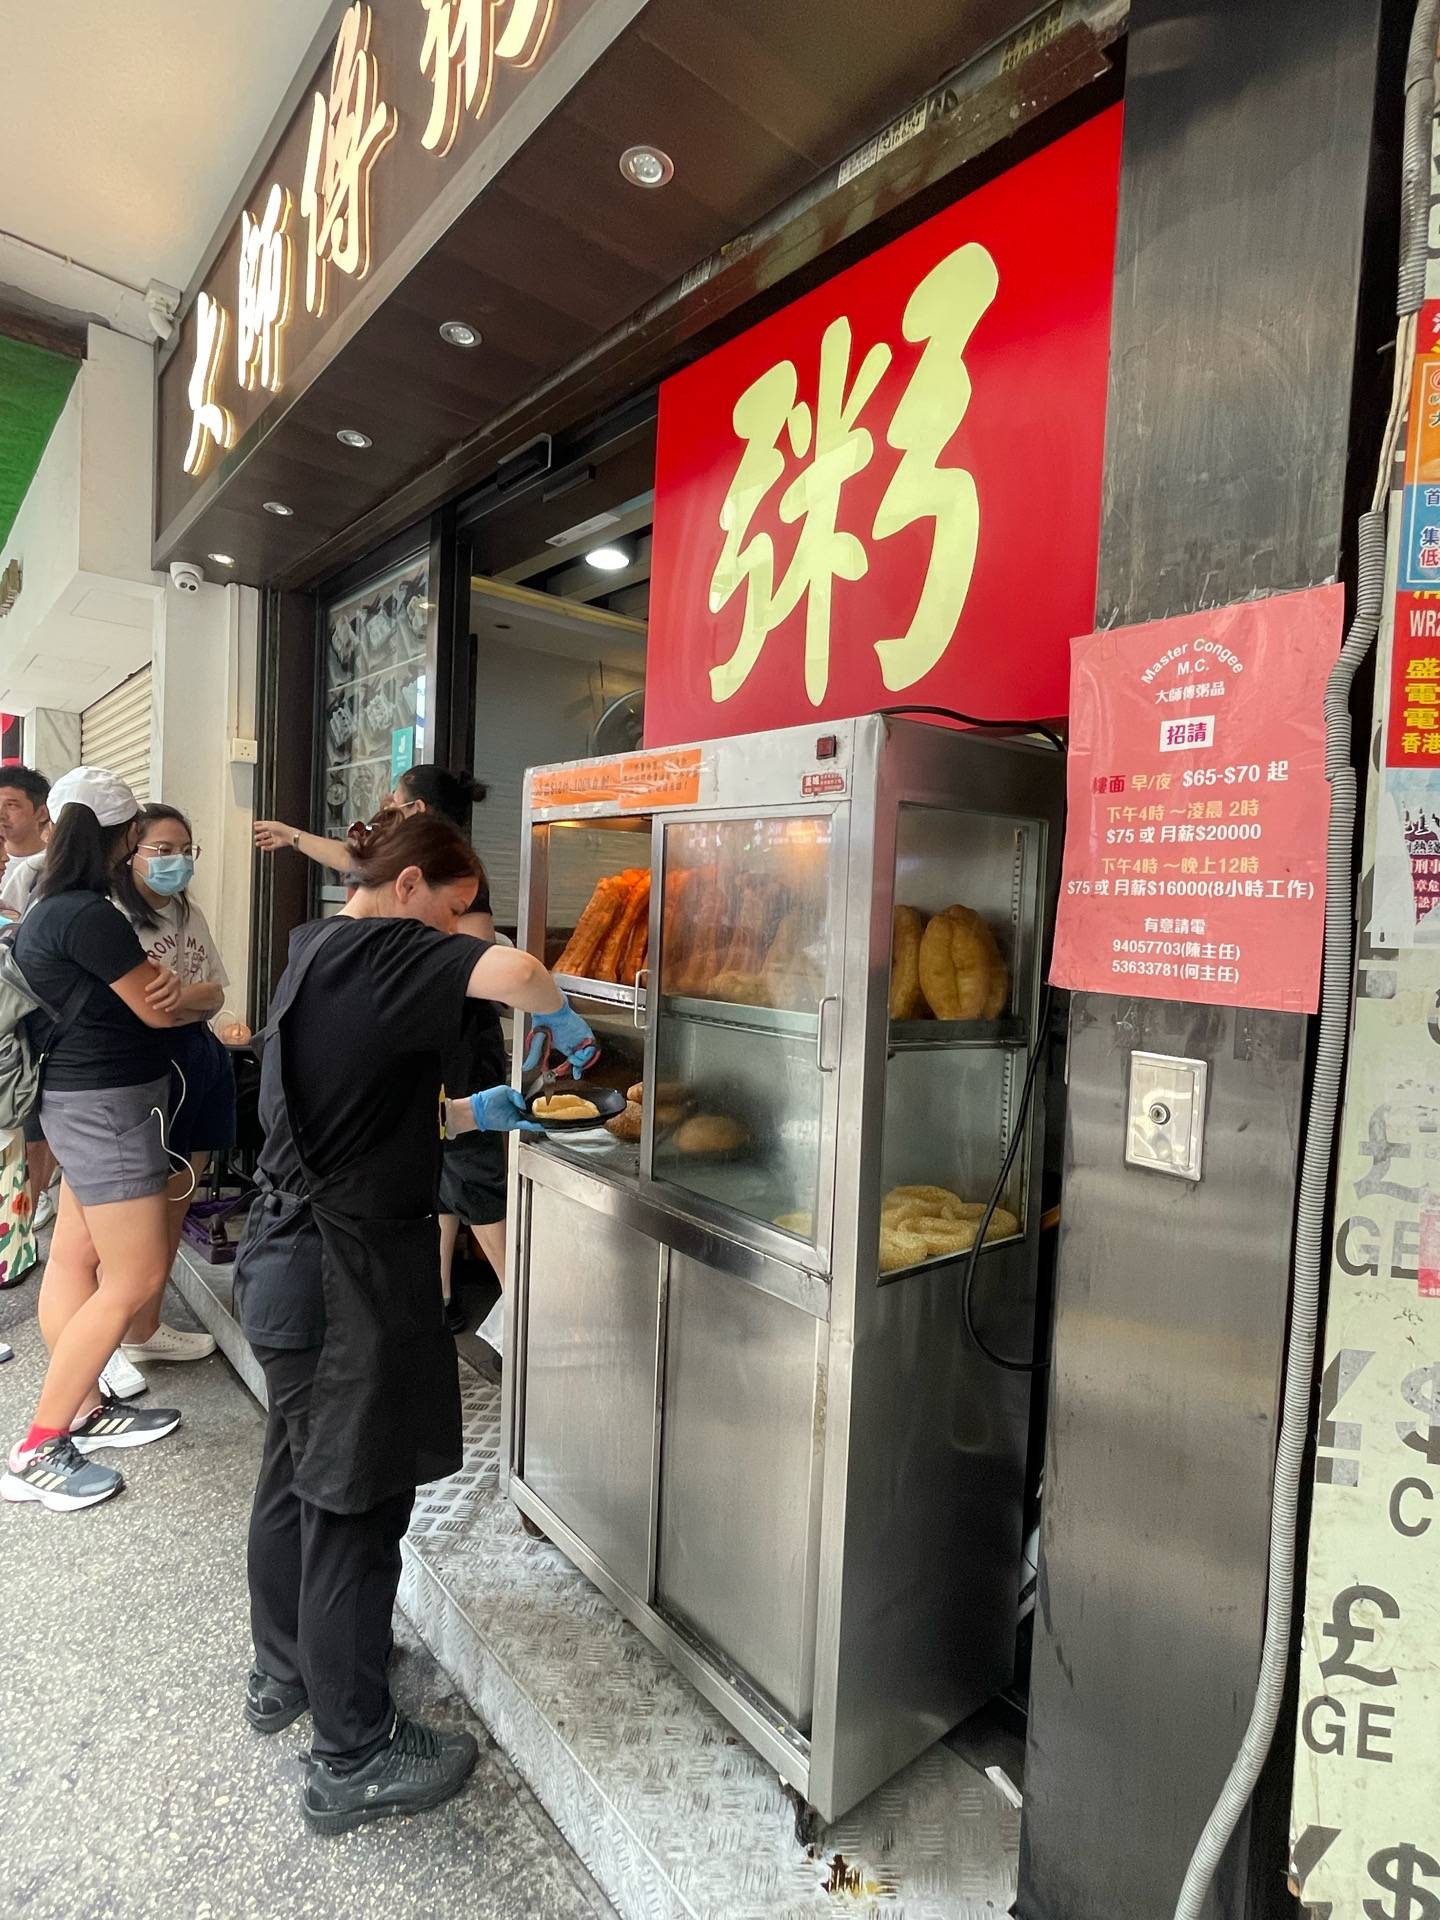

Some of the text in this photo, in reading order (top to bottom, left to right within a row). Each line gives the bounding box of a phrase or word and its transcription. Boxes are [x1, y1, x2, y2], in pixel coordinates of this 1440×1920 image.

[709, 242, 999, 706] 粥
[1141, 638, 1244, 684] Master Congee
[1177, 659, 1209, 676] M.C.
[1167, 722, 1207, 746] 招請
[1131, 773, 1172, 792] 早/夜
[1183, 764, 1260, 788] $65-$70
[1267, 760, 1289, 782] 起
[1107, 805, 1165, 824] 下午4時
[1106, 823, 1262, 844] $75 或 月薪$20000
[1101, 858, 1158, 875] 下午4時
[1067, 879, 1314, 900] $75 或 月薪$16000(8小時工作)
[1144, 917, 1206, 935] 有意請電
[147, 934, 178, 961] RON
[1112, 939, 1240, 961] 94057703(陳主任)
[1111, 960, 1240, 984] 53633781(何主任)
[1301, 1695, 1396, 1763] GE
